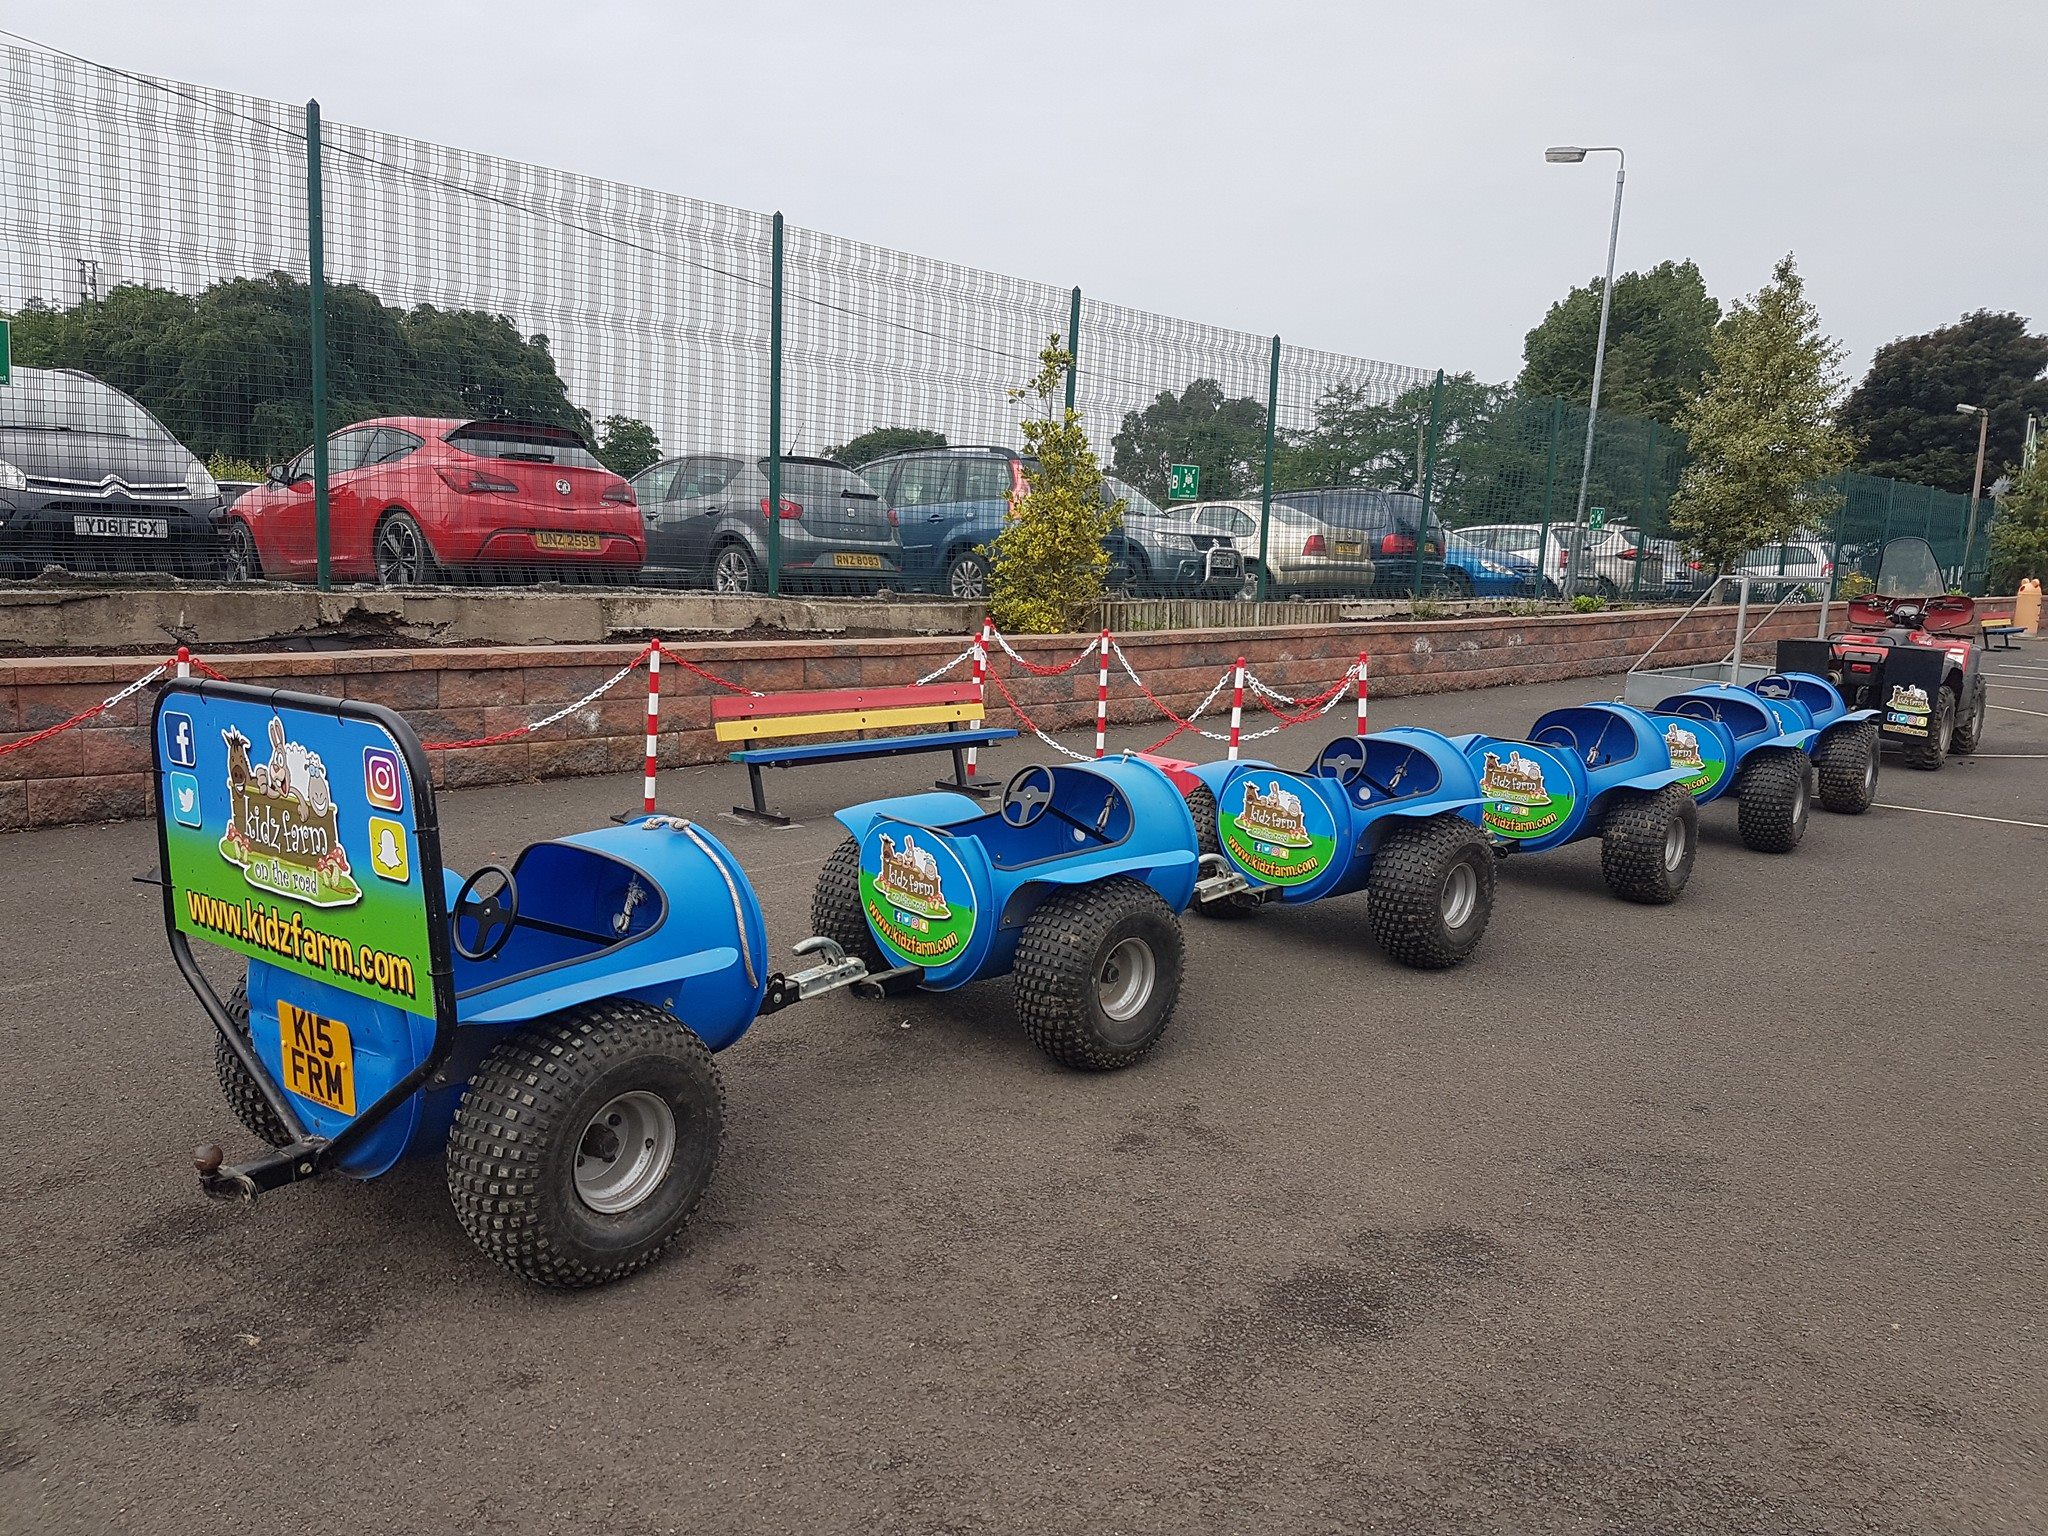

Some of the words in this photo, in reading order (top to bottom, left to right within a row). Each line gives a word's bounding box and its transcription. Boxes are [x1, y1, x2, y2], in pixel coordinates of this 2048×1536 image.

[1172, 474, 1179, 489] B
[540, 532, 565, 546] UNZ
[836, 555, 855, 565] RNZ
[1490, 771, 1511, 790] kidz
[1511, 777, 1537, 791] farm
[244, 795, 281, 852] kidz
[281, 809, 328, 856] farm
[1249, 804, 1271, 827] kidz
[1271, 811, 1297, 830] farm
[1228, 834, 1319, 878] www.kidzfarm.com
[254, 862, 269, 881] on
[272, 860, 290, 887] the
[292, 870, 319, 895] road
[887, 863, 908, 890] kidz
[908, 877, 935, 897] farm
[185, 888, 417, 1000] www.kidzfarm.com
[868, 899, 959, 957] www.kidzfarm.com
[291, 1046, 344, 1106] FRM
